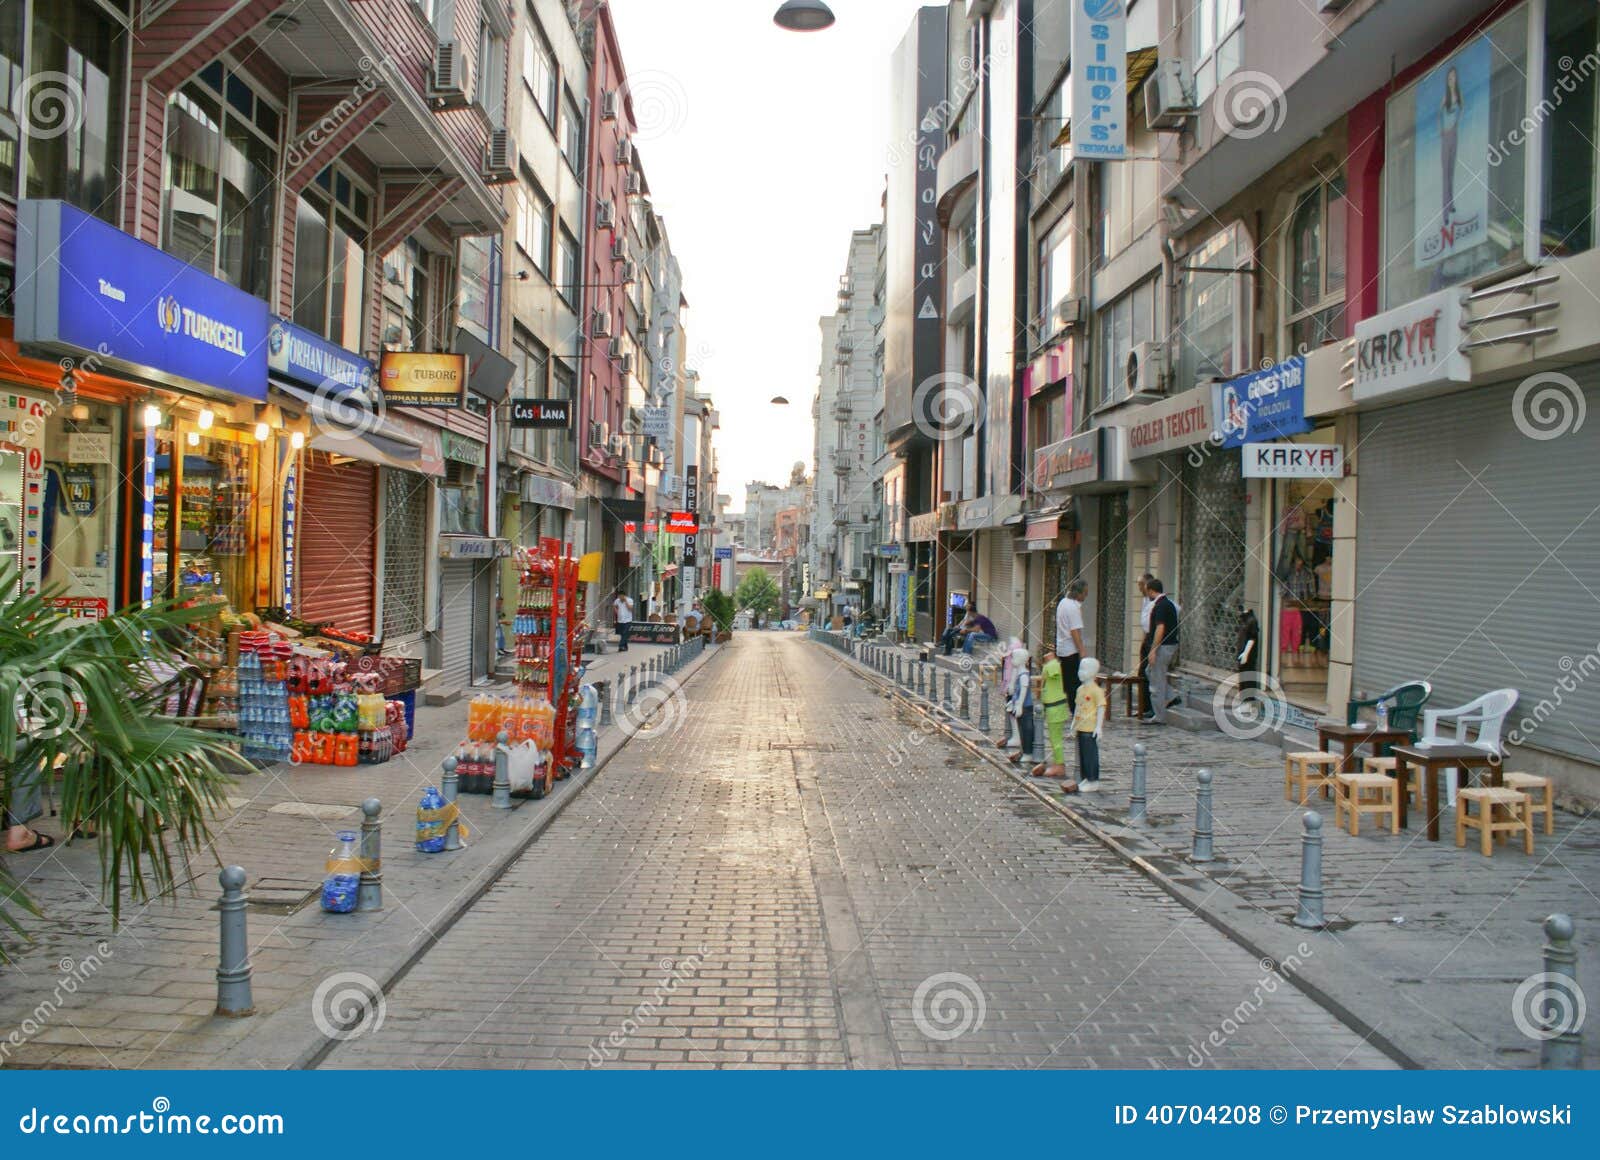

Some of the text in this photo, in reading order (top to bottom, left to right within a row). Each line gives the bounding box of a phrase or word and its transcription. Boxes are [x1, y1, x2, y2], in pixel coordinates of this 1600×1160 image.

[182, 307, 246, 357] TURKCELL
[1358, 316, 1436, 372] KARYA
[289, 336, 359, 389] ORHAN MARKET
[414, 368, 457, 381] TUBORG
[384, 394, 418, 402] ORHAN
[1130, 400, 1207, 448] GÖZLER TEKSTİL
[1257, 448, 1334, 466] KARYA
